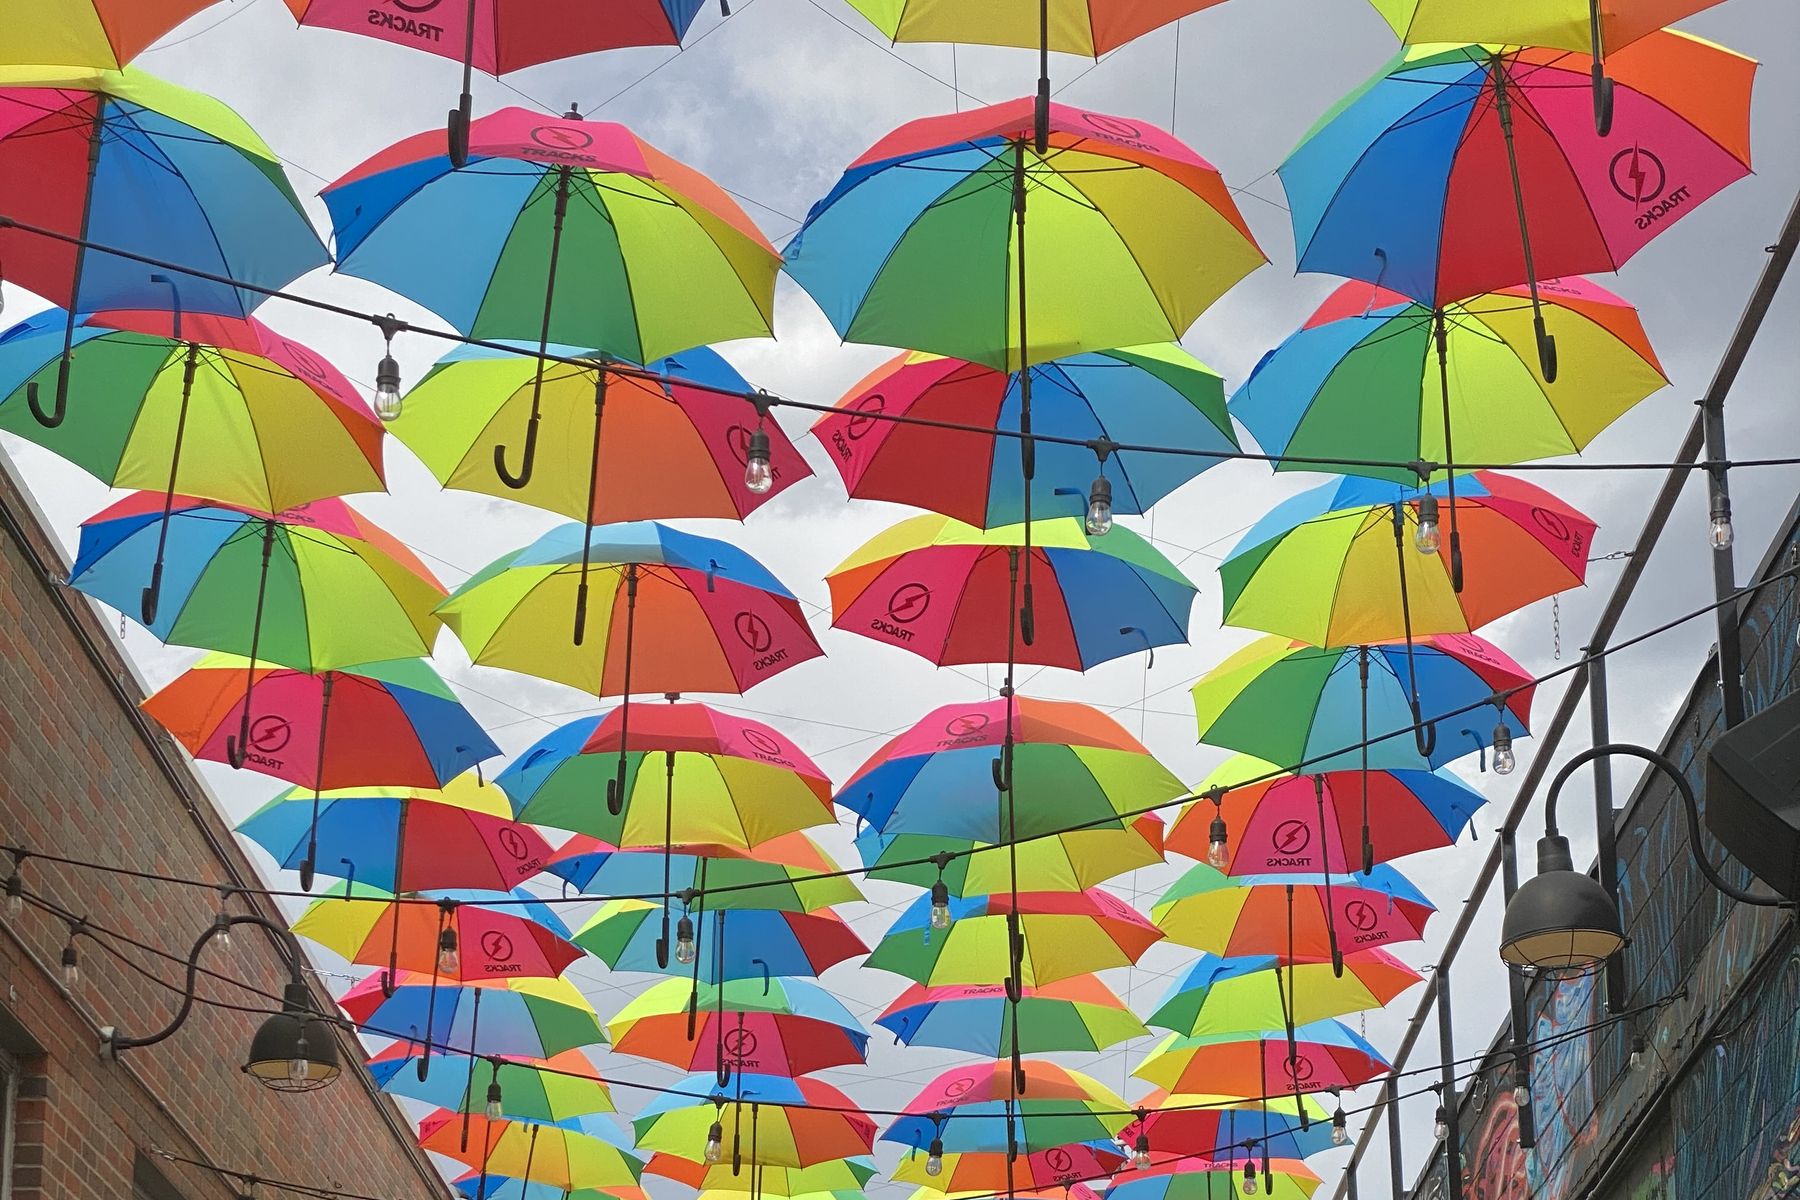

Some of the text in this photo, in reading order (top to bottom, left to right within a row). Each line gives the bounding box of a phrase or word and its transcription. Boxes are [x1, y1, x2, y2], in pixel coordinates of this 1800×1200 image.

[1094, 132, 1160, 153] TRACKS
[521, 148, 597, 162] TRACKS
[937, 734, 988, 747] TRACKS
[752, 751, 796, 768] TRACKS
[962, 987, 1003, 996] TRACKS
